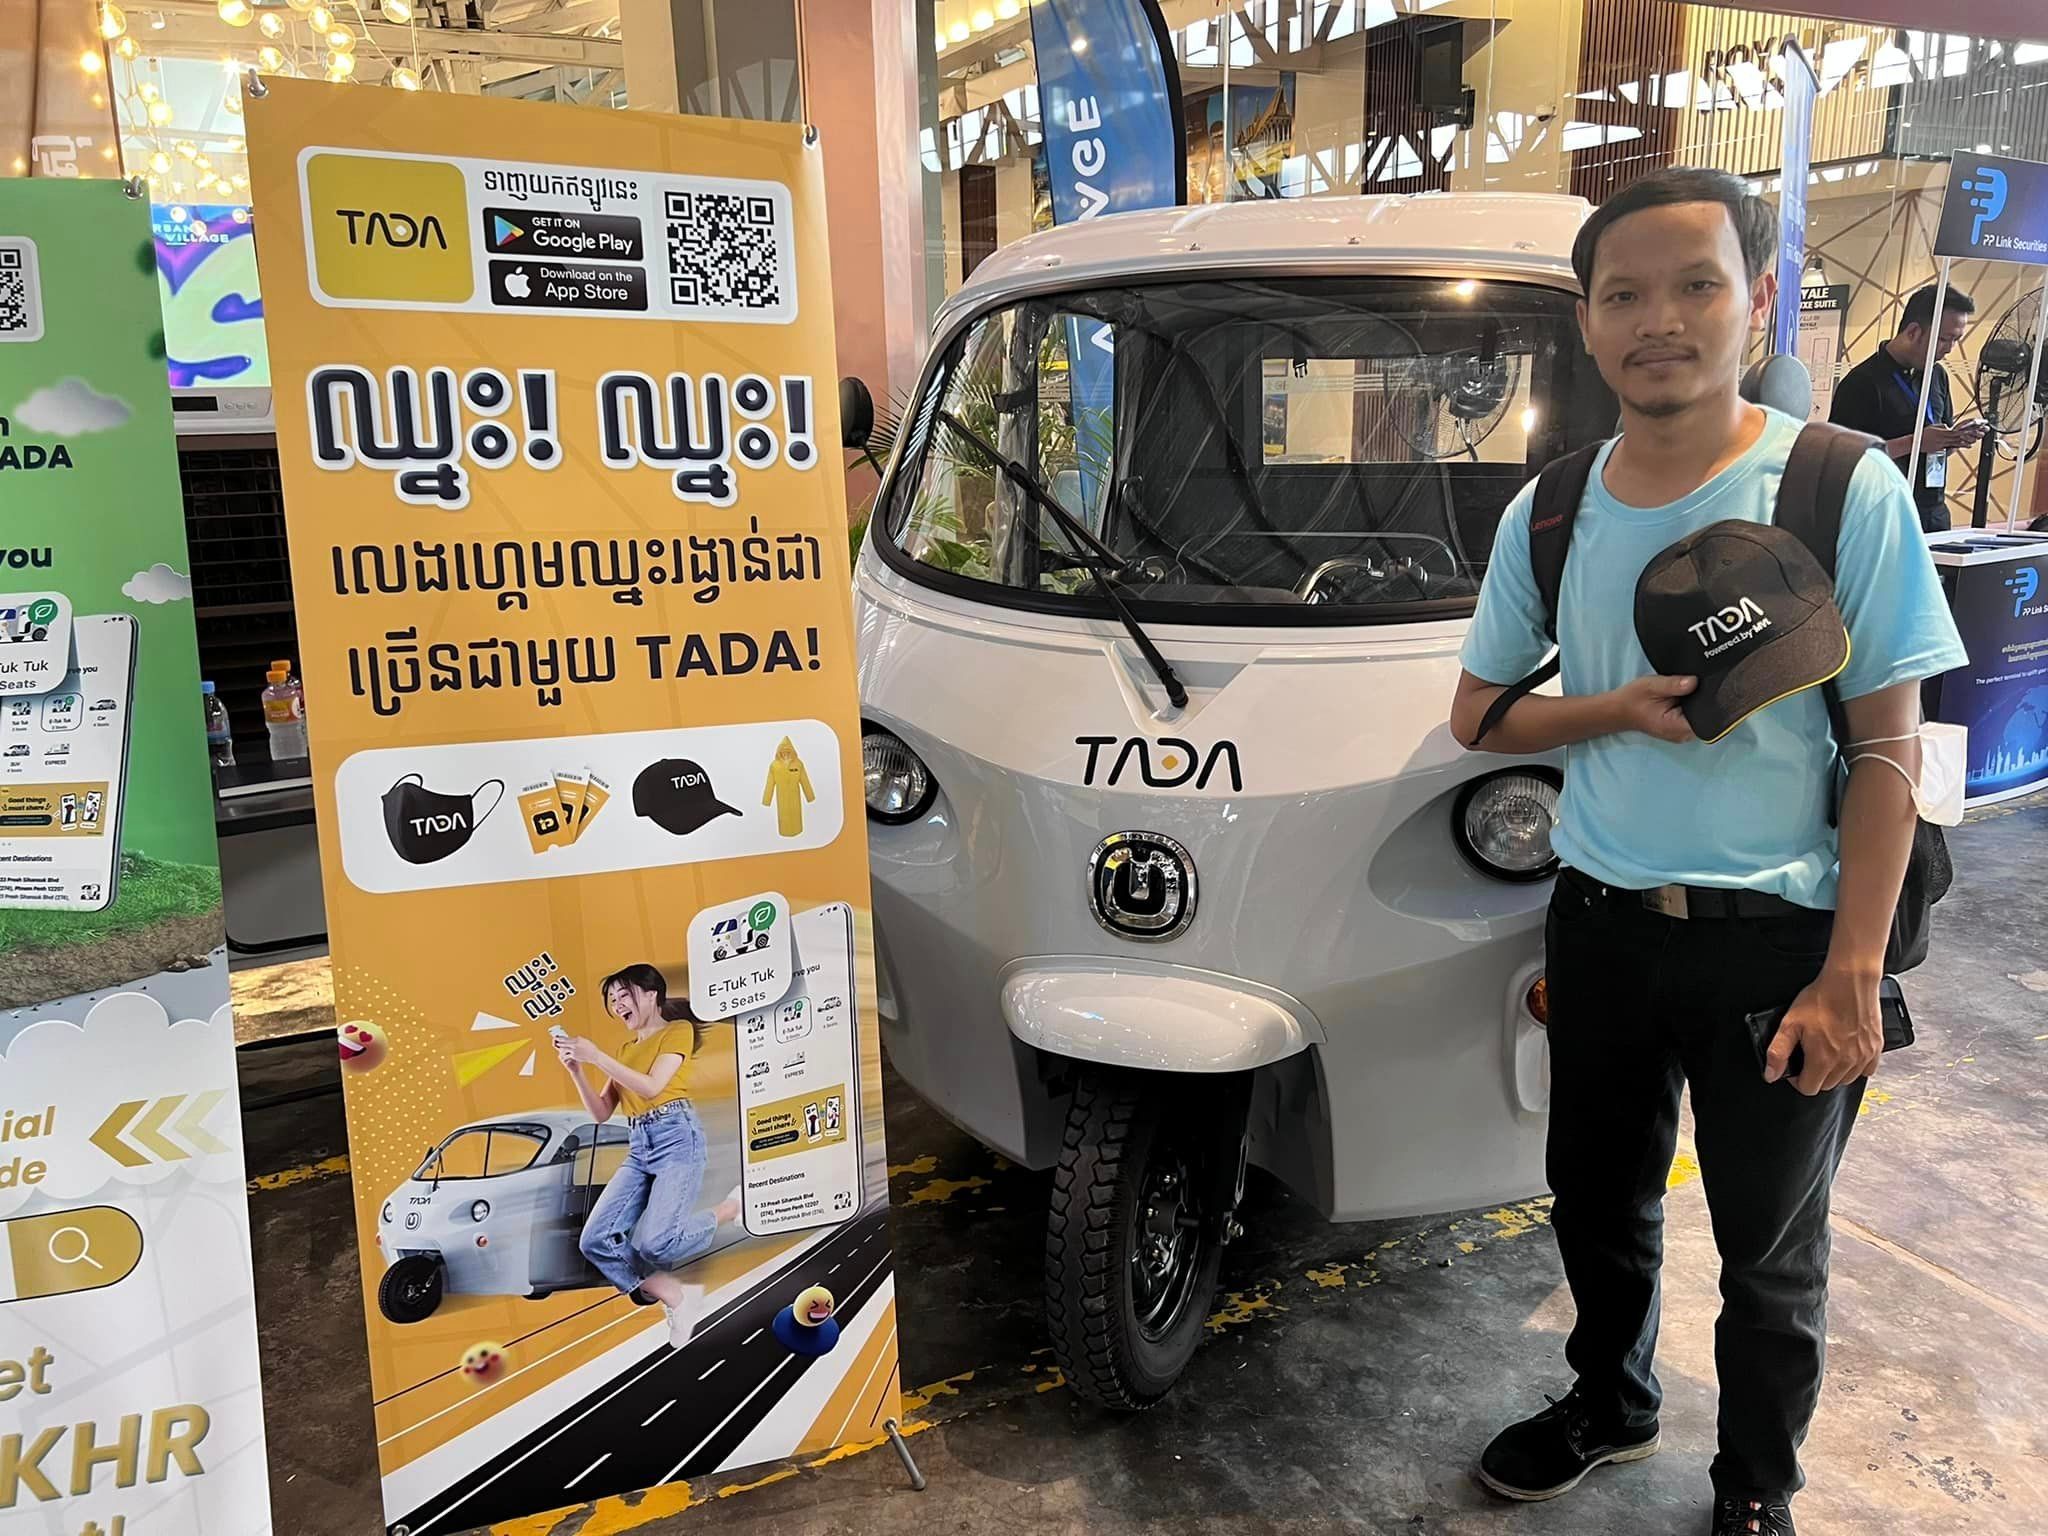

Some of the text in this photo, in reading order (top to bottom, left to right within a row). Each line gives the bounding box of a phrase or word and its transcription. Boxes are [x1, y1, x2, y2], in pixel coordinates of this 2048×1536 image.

[336, 209, 448, 250] TADA
[532, 217, 581, 229] GET IT ON
[165, 233, 230, 243] VILLAGE
[533, 229, 633, 255] Google Play
[1983, 234, 2047, 253] PP Link Securities
[540, 267, 633, 282] Download on the
[545, 282, 628, 302] App Store
[1814, 299, 1838, 308] SUITE
[309, 367, 815, 503] ឈ្នះ! ឈ្នះ!
[1688, 597, 1764, 647] TADA
[1704, 636, 1741, 659] Powered
[1740, 629, 1753, 639] by
[24, 660, 48, 672] Tuk
[83, 666, 98, 674] you
[347, 626, 821, 716] ច្រើនជាមួយ TADA!
[1986, 676, 2003, 685] perfect
[1075, 736, 1243, 792] TADA
[671, 772, 706, 790] TADA
[410, 813, 467, 839] TADA
[708, 967, 776, 998] E-Tuk Tuk
[805, 964, 821, 978] you
[719, 991, 767, 1013] 3 Seats
[1, 1105, 56, 1143] ial
[0, 1157, 47, 1189] de
[748, 1172, 805, 1189] Recent Destinations
[0, 1346, 54, 1401] et
[0, 1403, 212, 1510] KHR
